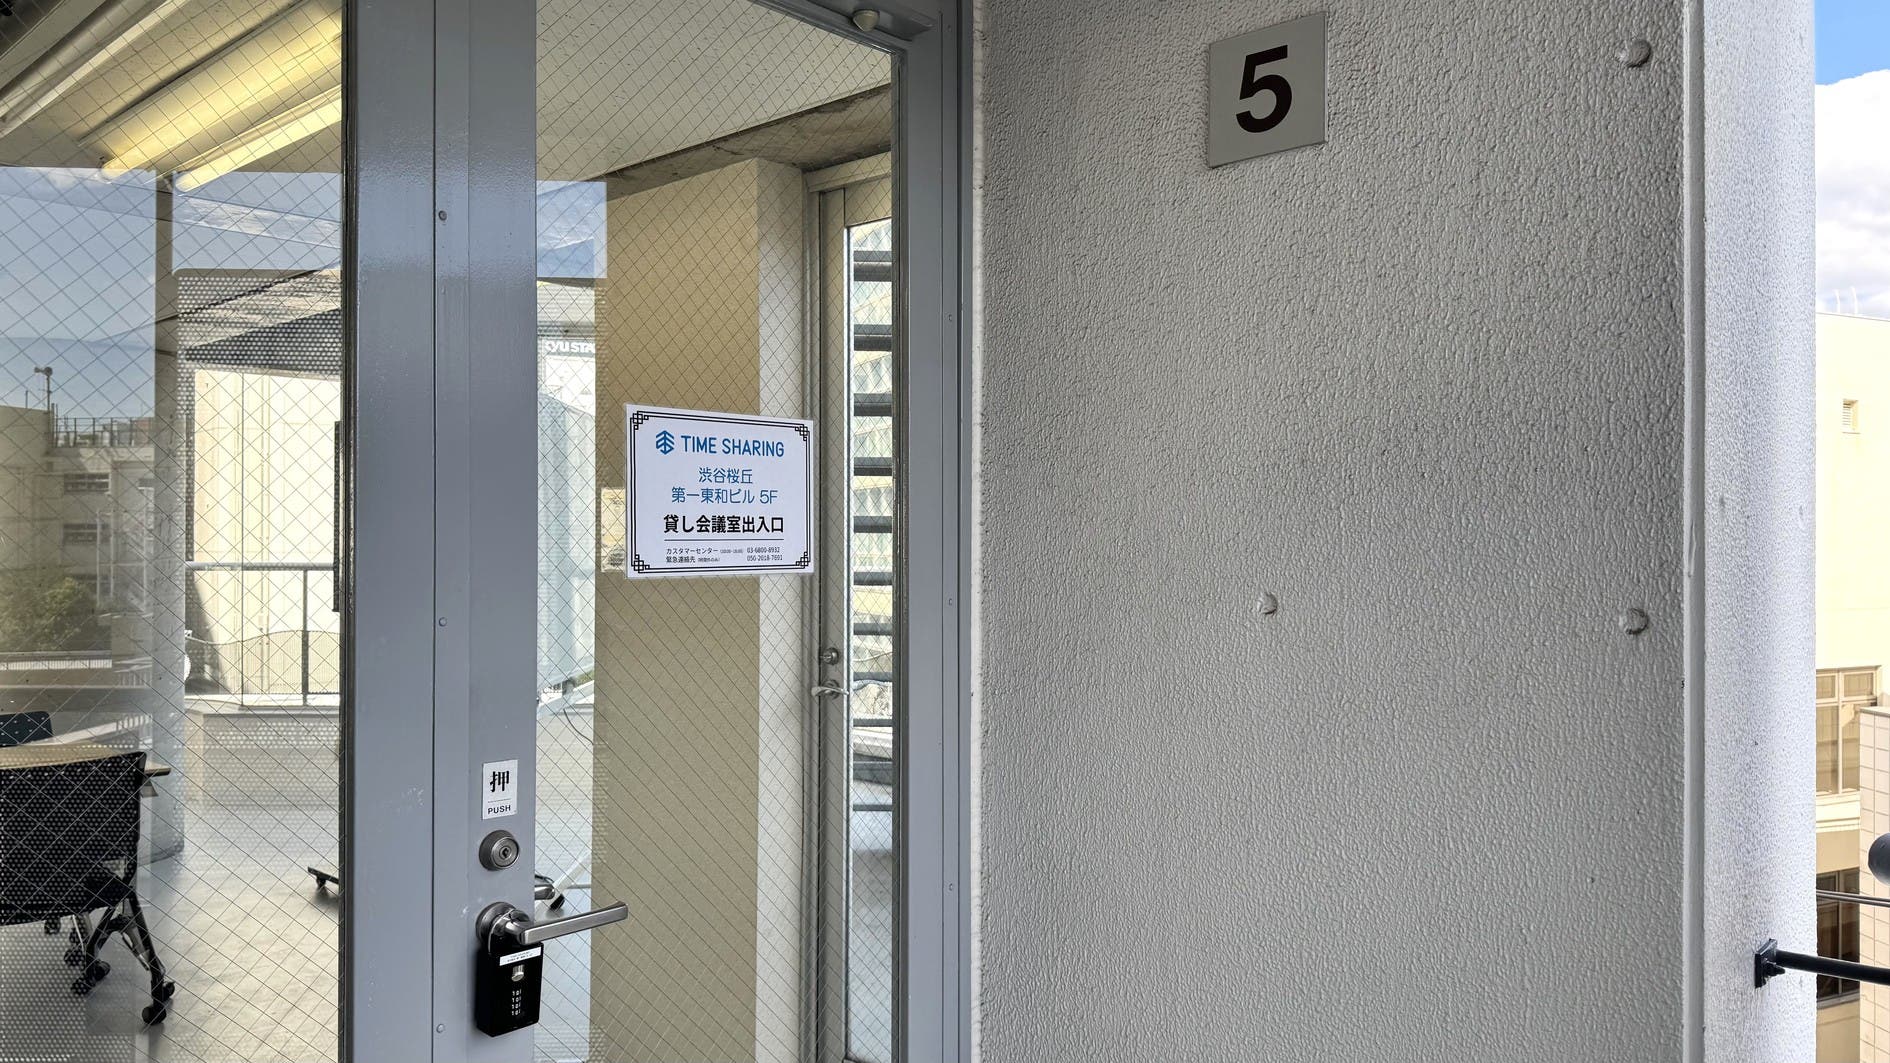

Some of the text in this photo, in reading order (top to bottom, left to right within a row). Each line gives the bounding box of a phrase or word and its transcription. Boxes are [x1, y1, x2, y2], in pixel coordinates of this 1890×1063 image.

[1236, 44, 1292, 133] 5
[680, 435, 785, 457] TIME SHARING
[698, 467, 753, 484] 渋谷桜丘
[671, 486, 778, 504] 第一東和ビル 5F
[663, 514, 784, 533] 貸し会議室出入口
[490, 770, 510, 792] 押
[487, 804, 511, 815] PUSH
